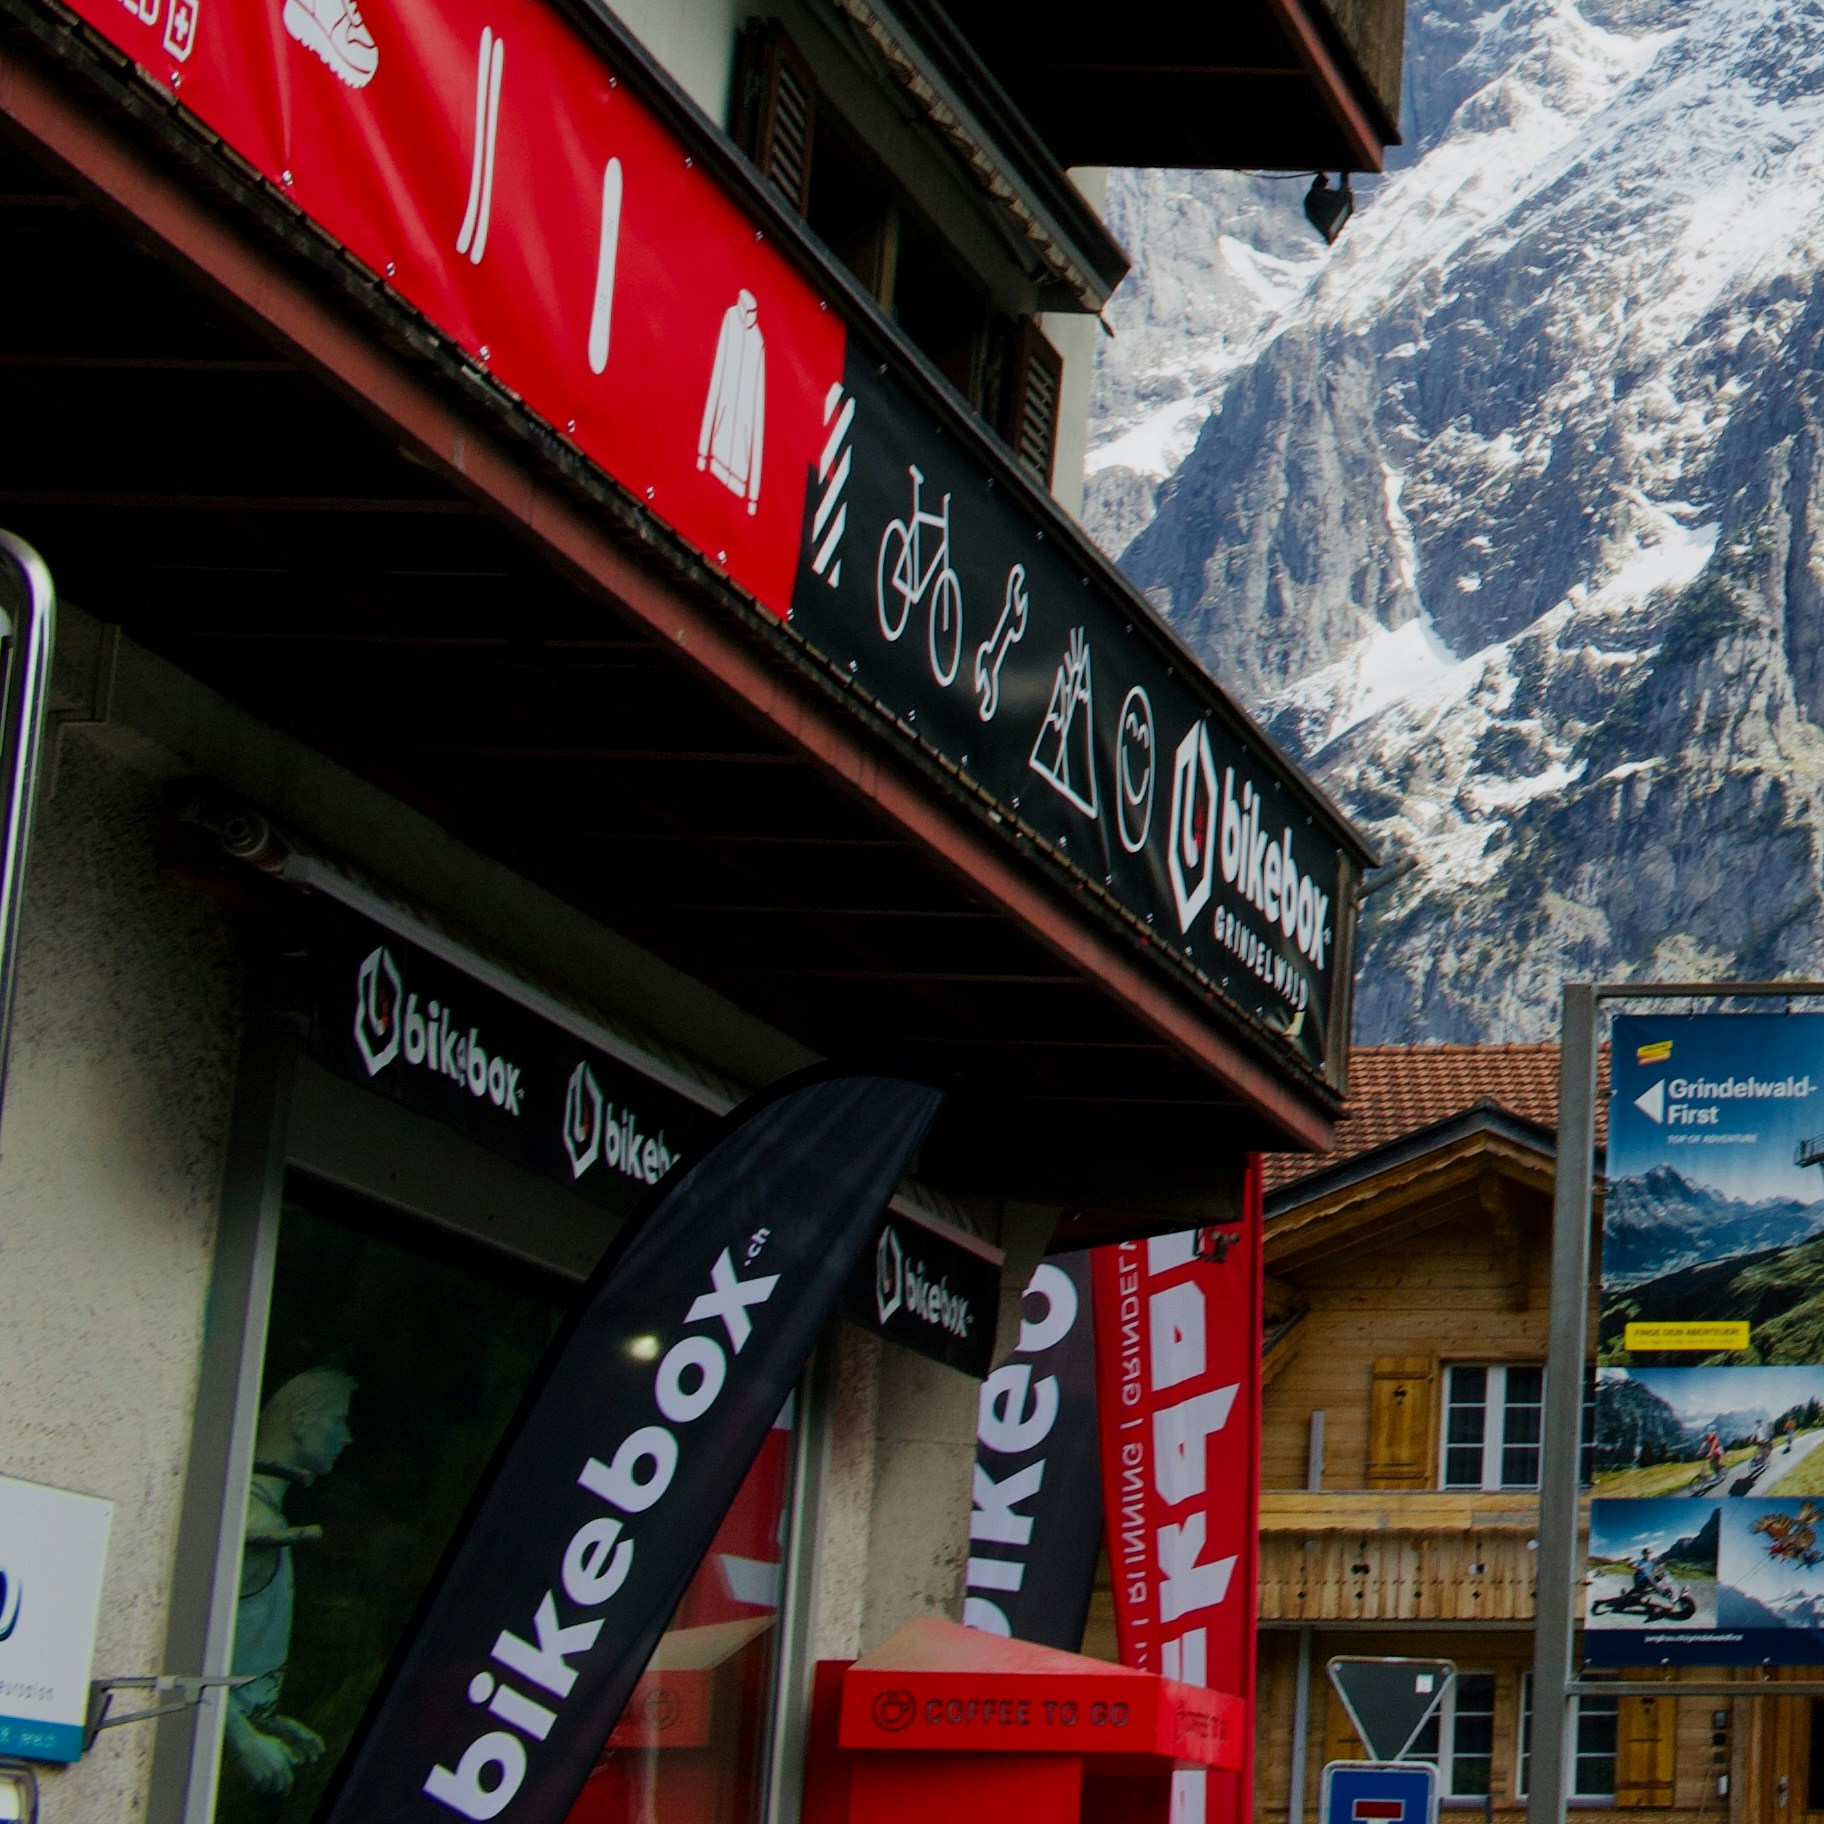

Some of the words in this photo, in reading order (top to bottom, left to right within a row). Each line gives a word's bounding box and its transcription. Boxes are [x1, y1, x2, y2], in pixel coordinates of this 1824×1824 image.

[1220, 766, 1330, 971] bikebox
[1213, 904, 1310, 1012] GRINDELWALD
[403, 993, 521, 1117] bikebox
[1668, 1076, 1819, 1100] Grindelwald-
[1667, 1103, 1720, 1125] First
[924, 1698, 1032, 1727] COFFEE
[1042, 1699, 1079, 1727] TO
[1090, 1701, 1130, 1728] GO
